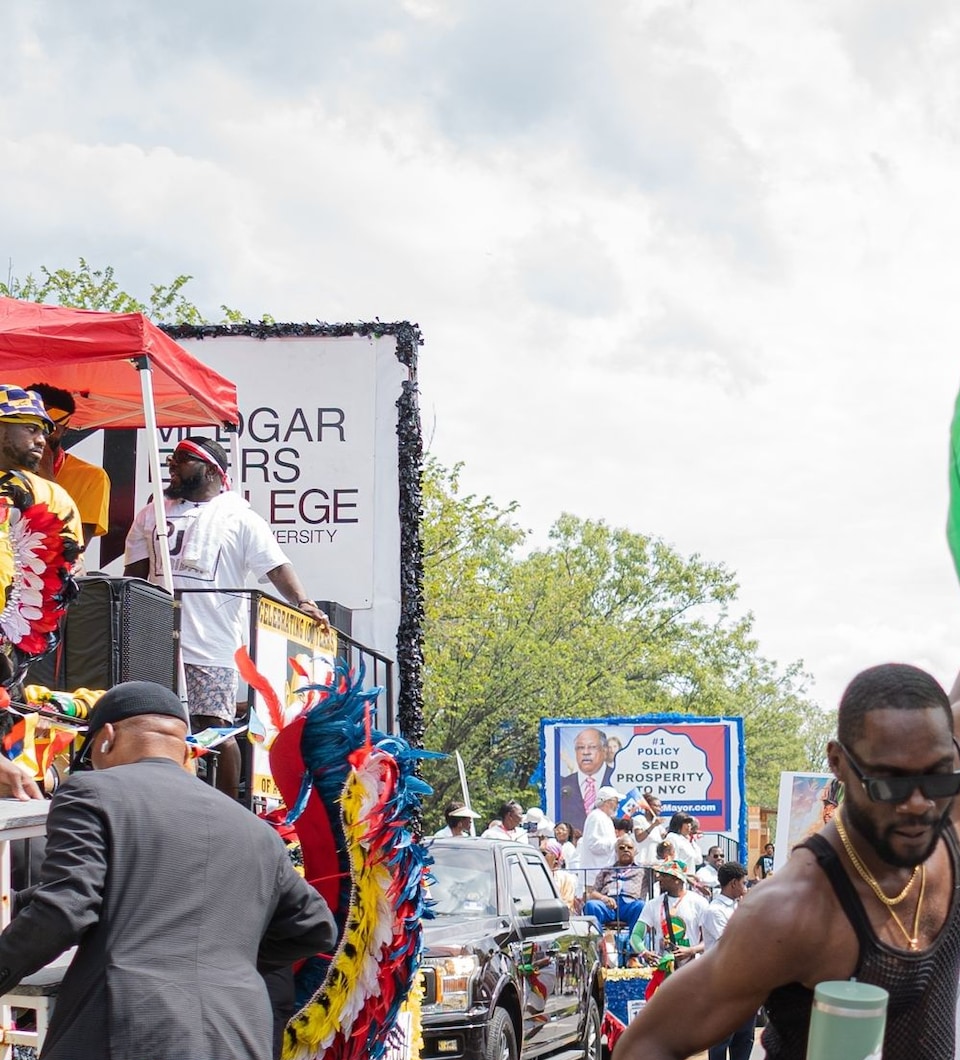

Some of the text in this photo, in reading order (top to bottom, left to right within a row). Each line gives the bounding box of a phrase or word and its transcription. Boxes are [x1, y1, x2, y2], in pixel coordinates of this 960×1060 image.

[149, 447, 301, 484] ERS
[273, 529, 338, 544] ERSITY
[652, 737, 665, 746] #1
[637, 747, 680, 756] POLICY
[641, 761, 679, 770] SEND
[616, 772, 704, 783] PROSPERITY
[261, 778, 271, 793] OF
[636, 785, 687, 795] TO NYC
